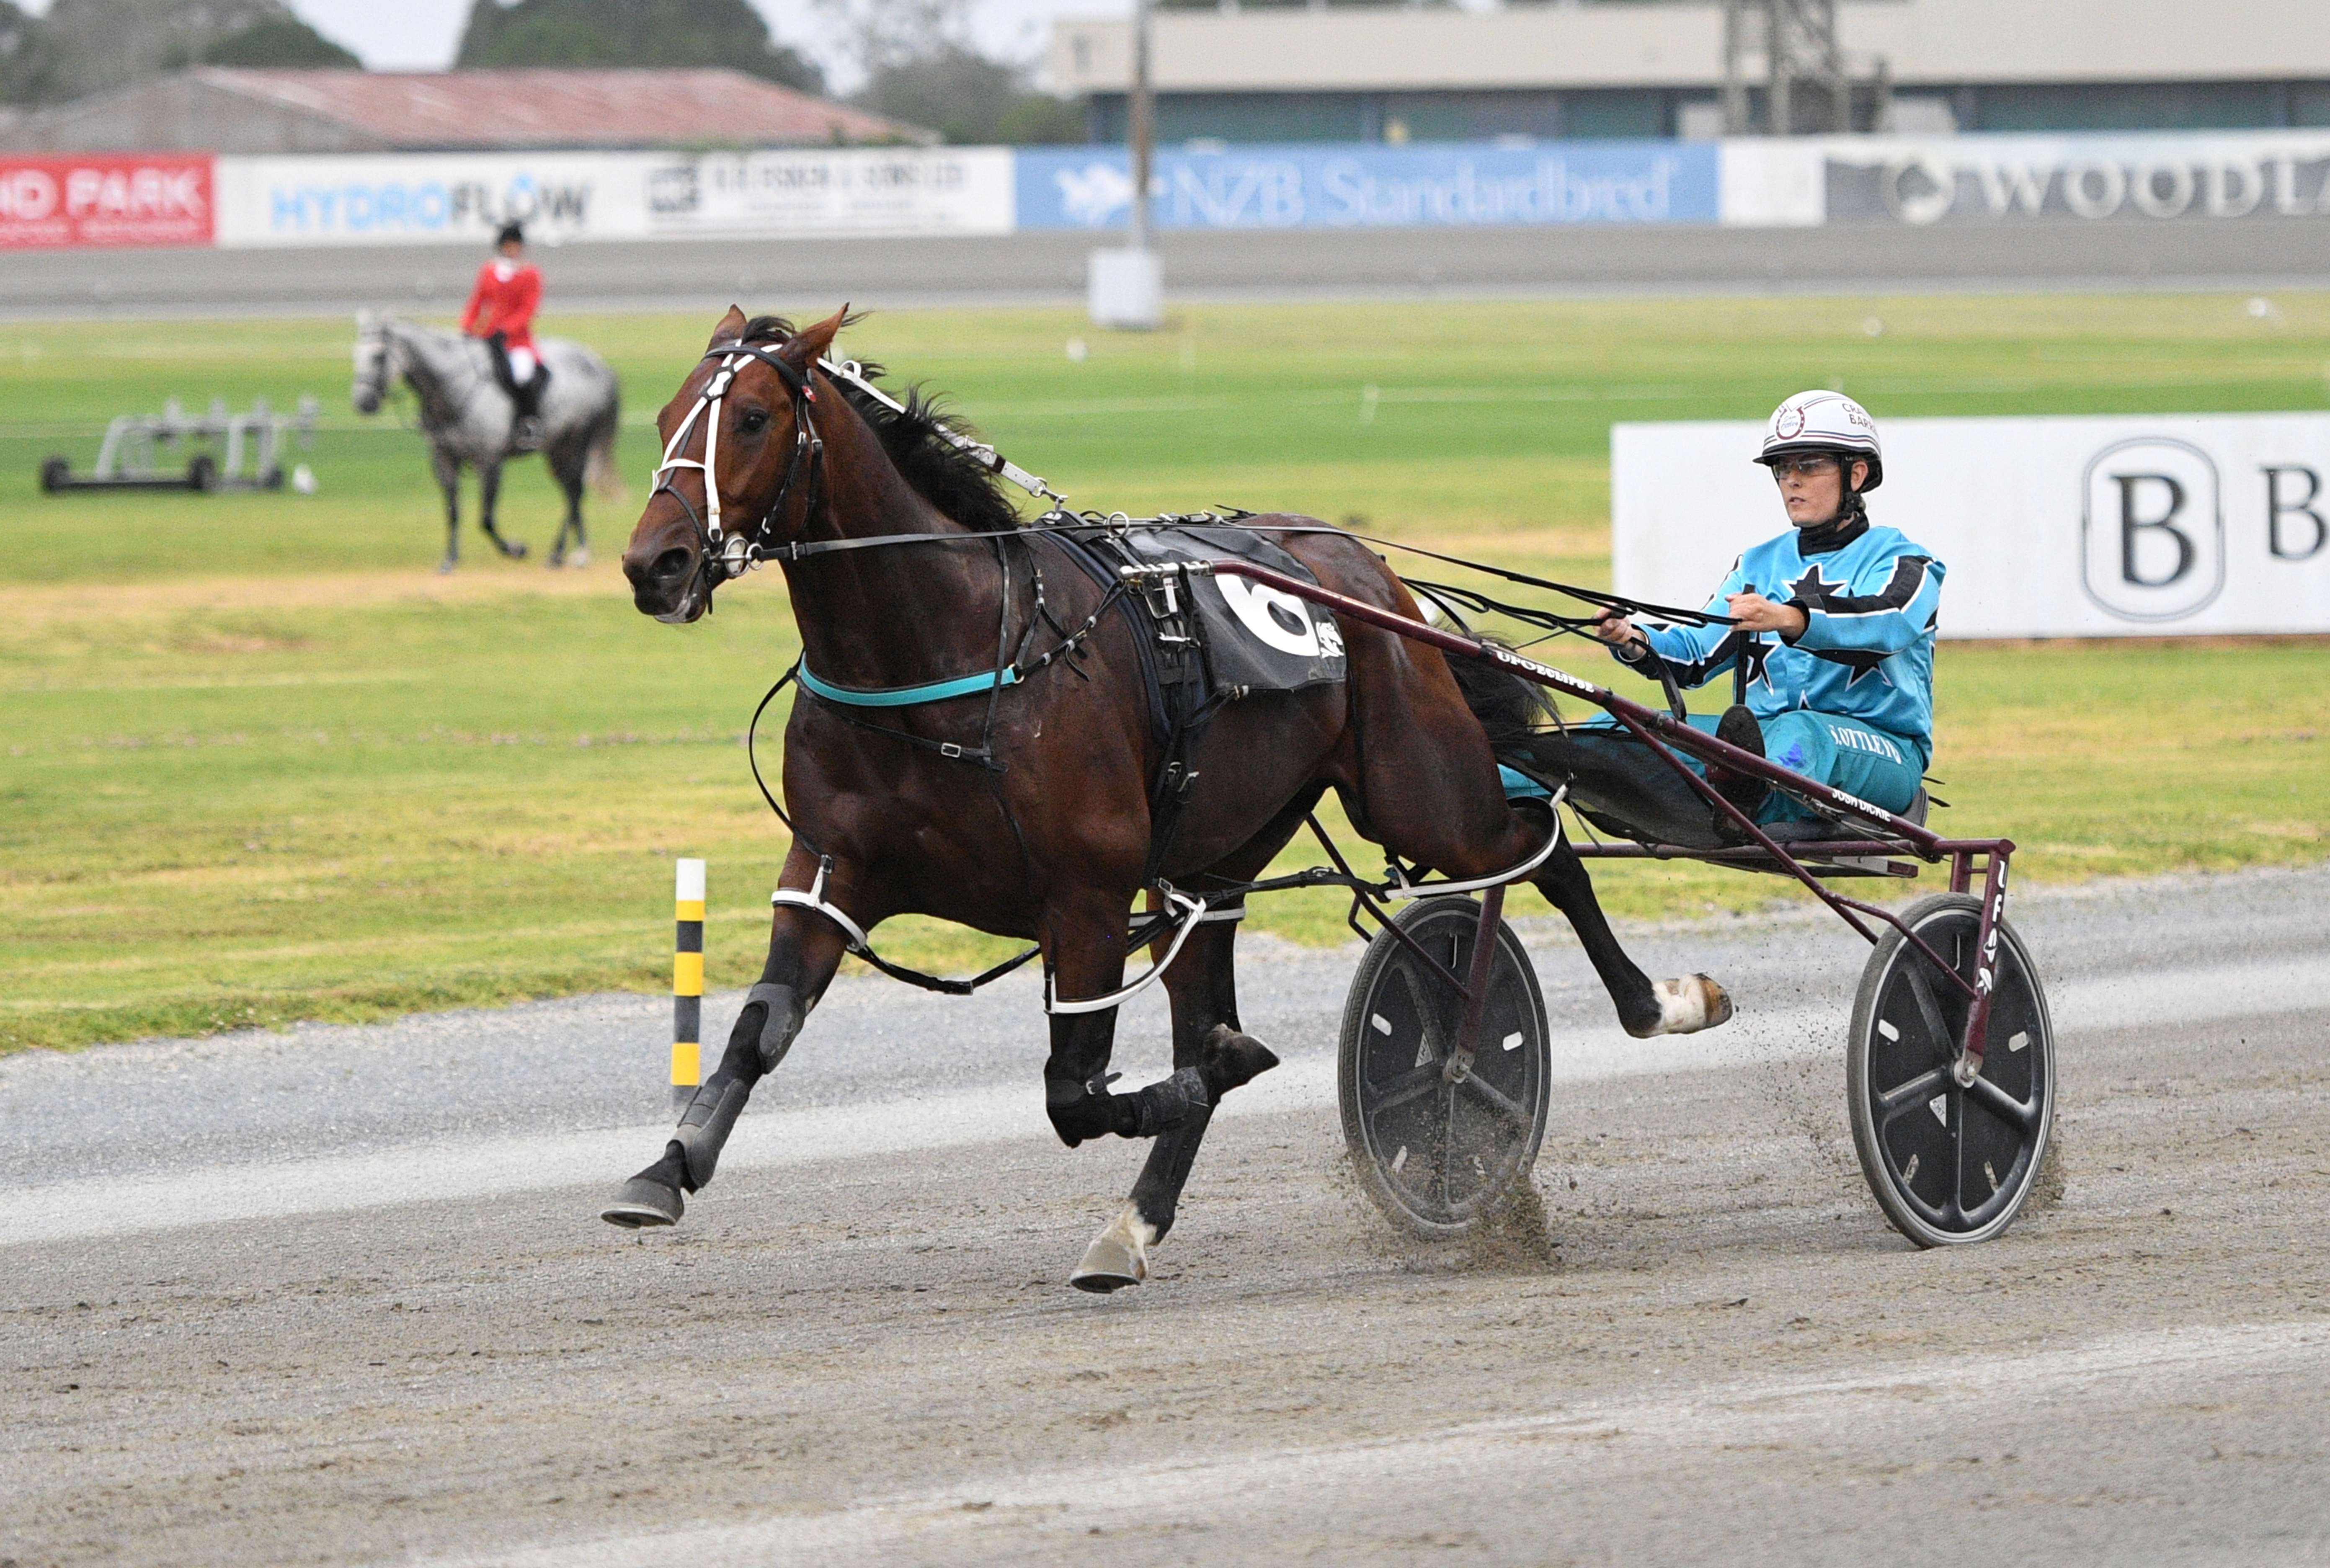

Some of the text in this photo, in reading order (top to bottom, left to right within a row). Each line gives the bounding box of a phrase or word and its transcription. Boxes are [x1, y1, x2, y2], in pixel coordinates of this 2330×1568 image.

[0, 168, 204, 218] D PARK
[269, 172, 594, 230] HYDROFLOW
[1171, 156, 1671, 226] NZB Standardbred
[1975, 156, 2330, 219] WOODL
[2108, 473, 2195, 588] B
[2260, 463, 2329, 560] B
[1215, 574, 1320, 657] 6
[1832, 789, 1891, 822] JOSH DICKIE
